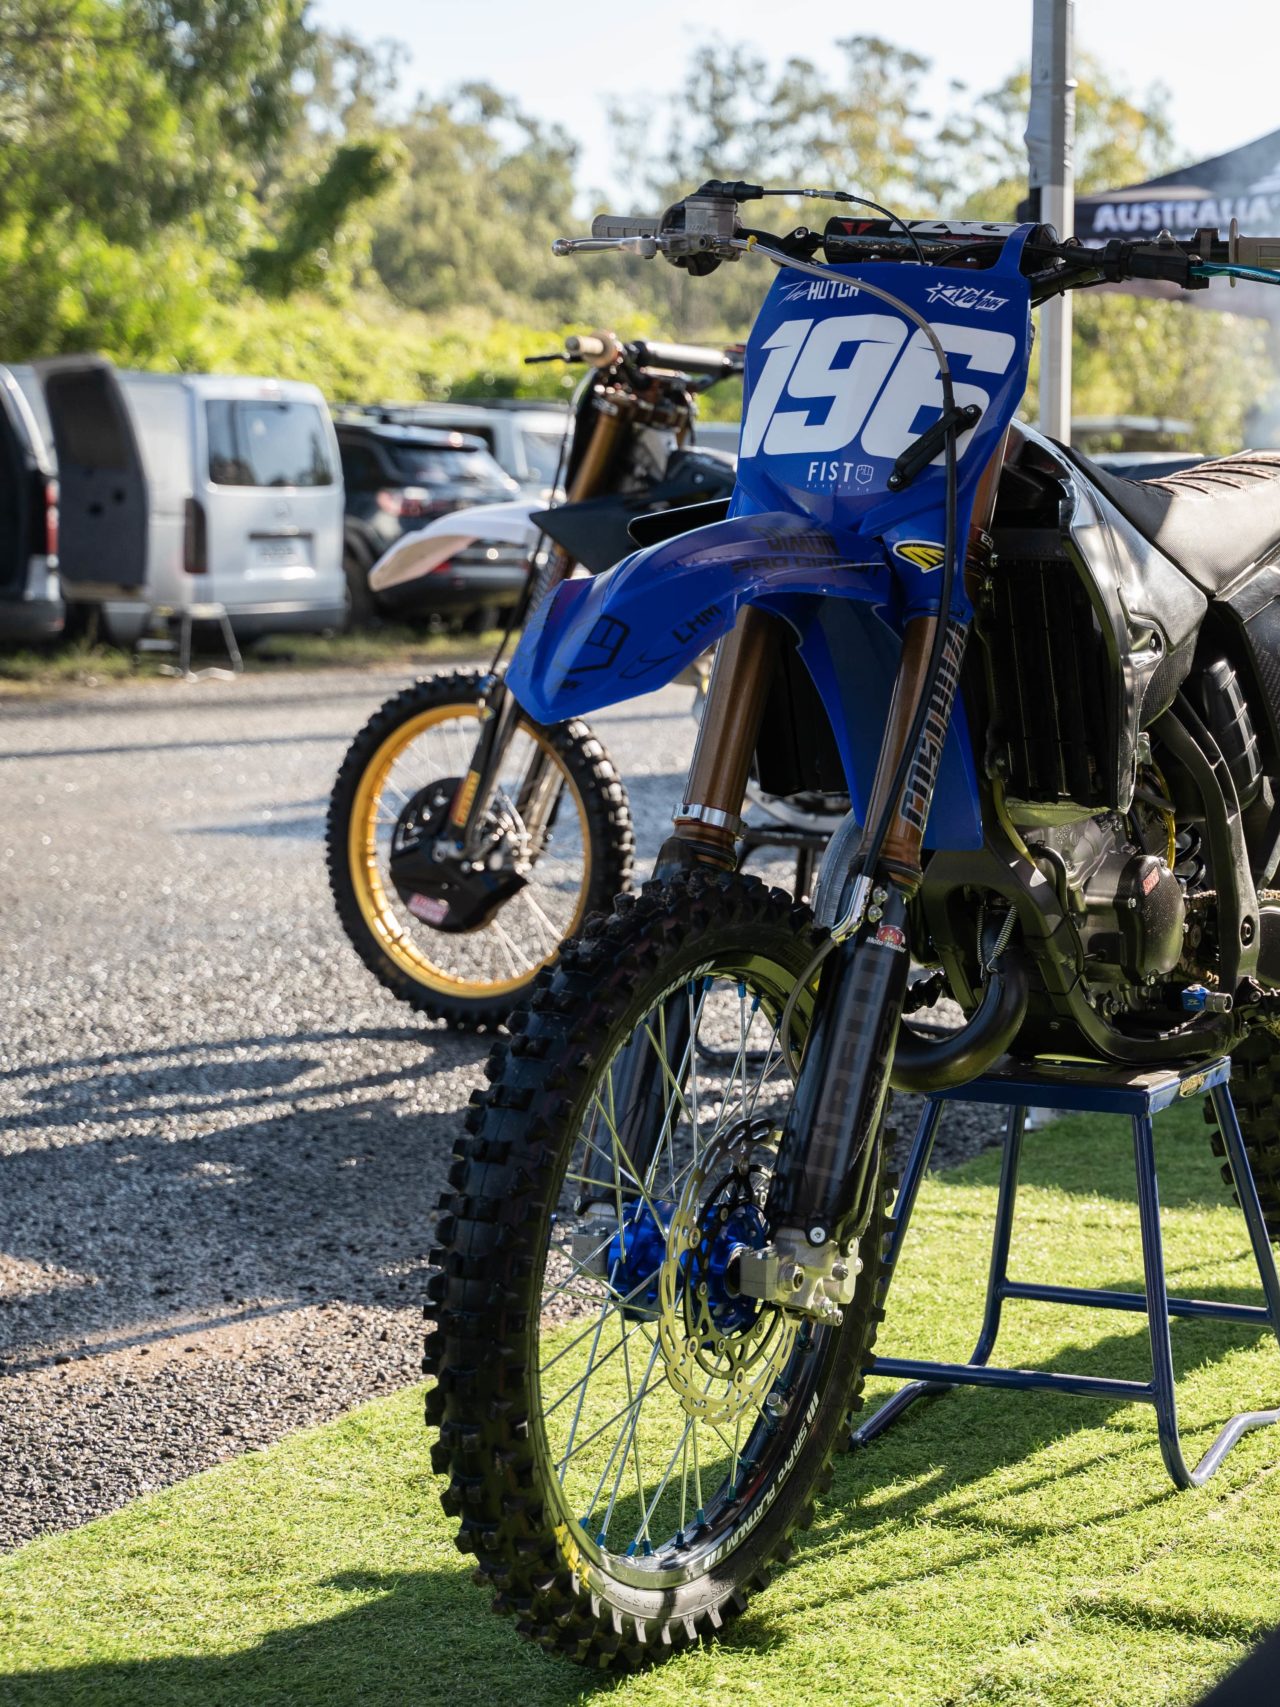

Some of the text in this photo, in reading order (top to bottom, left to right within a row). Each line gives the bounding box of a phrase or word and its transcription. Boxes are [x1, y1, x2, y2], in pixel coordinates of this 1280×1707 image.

[740, 313, 1016, 466] 196
[807, 461, 855, 483] FIST
[726, 1483, 776, 1553] PLATINUM
